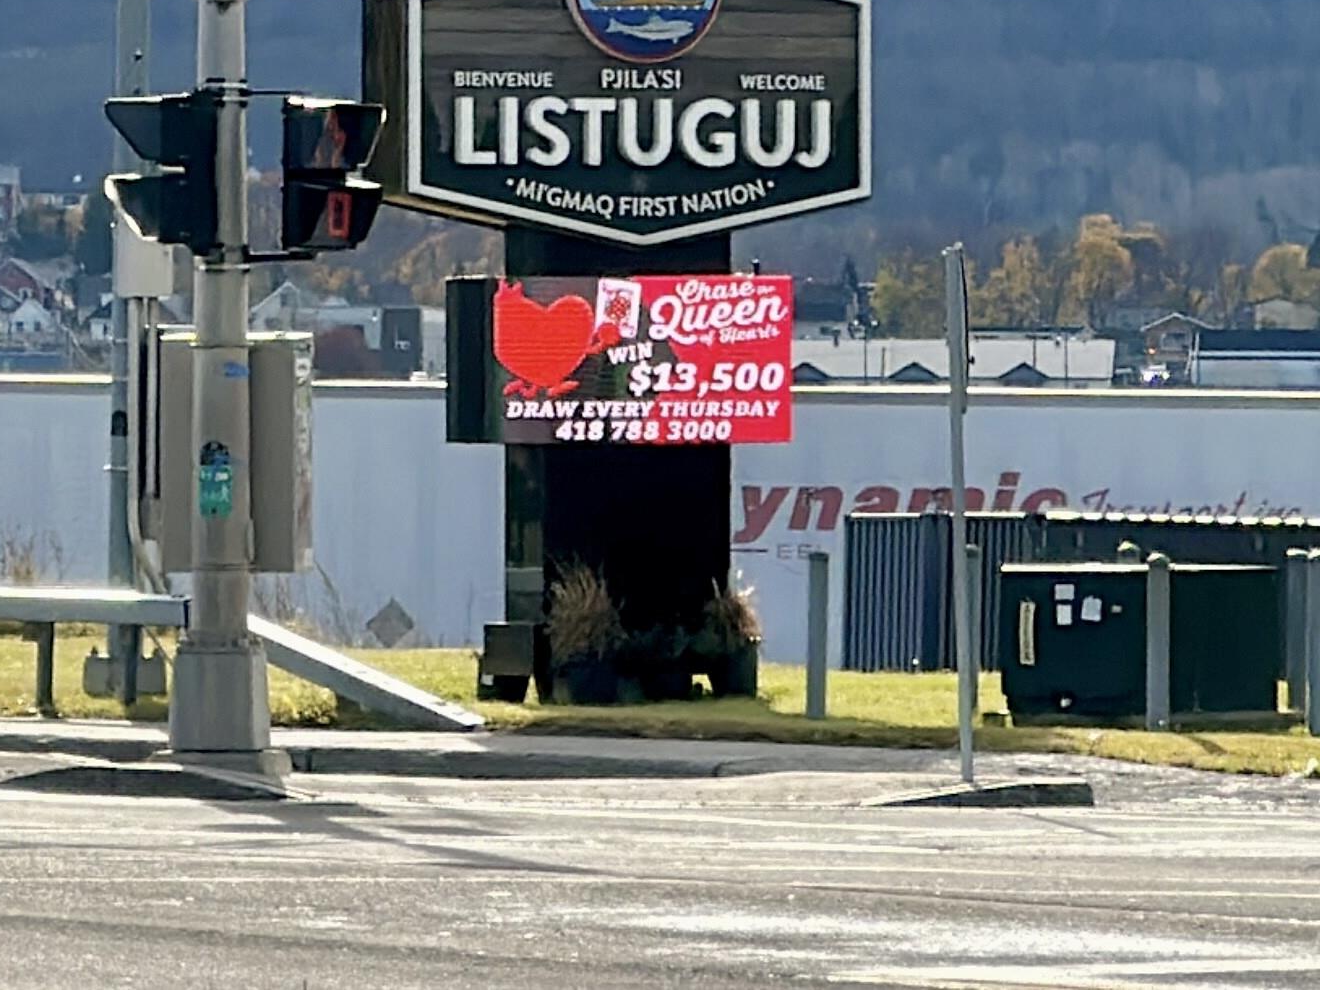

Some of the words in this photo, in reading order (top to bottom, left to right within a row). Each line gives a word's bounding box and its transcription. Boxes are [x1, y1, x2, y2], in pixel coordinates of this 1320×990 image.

[453, 71, 553, 89] BIENVENUE
[600, 68, 681, 89] PJILA'SI
[740, 73, 826, 91] WELCOME
[453, 96, 832, 168] LISTUGUJ
[515, 178, 613, 219] MI'GMAQ
[619, 198, 678, 218] FIRST
[682, 179, 766, 214] NATION
[675, 279, 756, 304] Chase
[648, 295, 789, 345] Queen
[606, 341, 654, 365] WIN
[629, 361, 785, 398] $13,500
[506, 400, 578, 419] DRAW
[582, 400, 655, 418] EVERY
[659, 399, 780, 418] THURSDAY
[555, 421, 604, 442] 418
[666, 421, 733, 441] 3000
[733, 471, 1067, 543] ynamic
